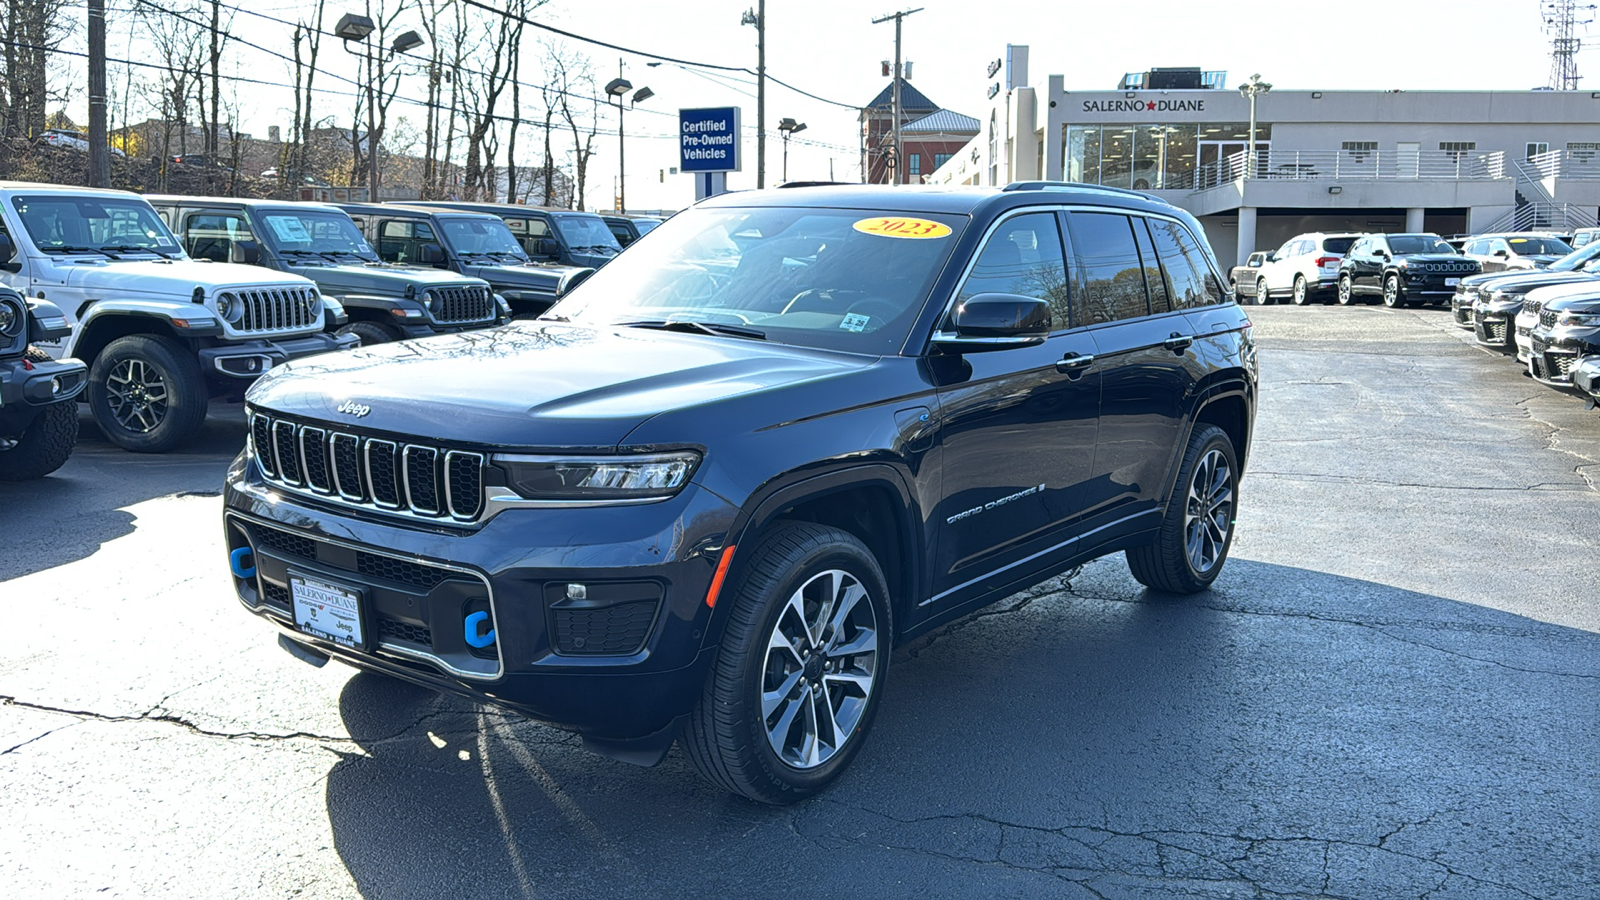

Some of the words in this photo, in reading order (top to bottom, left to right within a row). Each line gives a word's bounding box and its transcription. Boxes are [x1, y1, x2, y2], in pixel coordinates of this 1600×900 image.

[1082, 100, 1145, 112] SALERNO
[1158, 100, 1205, 112] DUANE
[682, 120, 726, 132] Certified
[682, 133, 733, 146] Pre-Owned
[683, 147, 727, 160] Vehicles
[867, 220, 938, 235] 2023
[337, 399, 371, 418] Jeep
[946, 505, 983, 524] GRAND
[984, 486, 1037, 510] CHEROKEE
[294, 585, 328, 602] SALERNO
[331, 595, 357, 611] DUANE
[336, 620, 354, 633] Jeep
